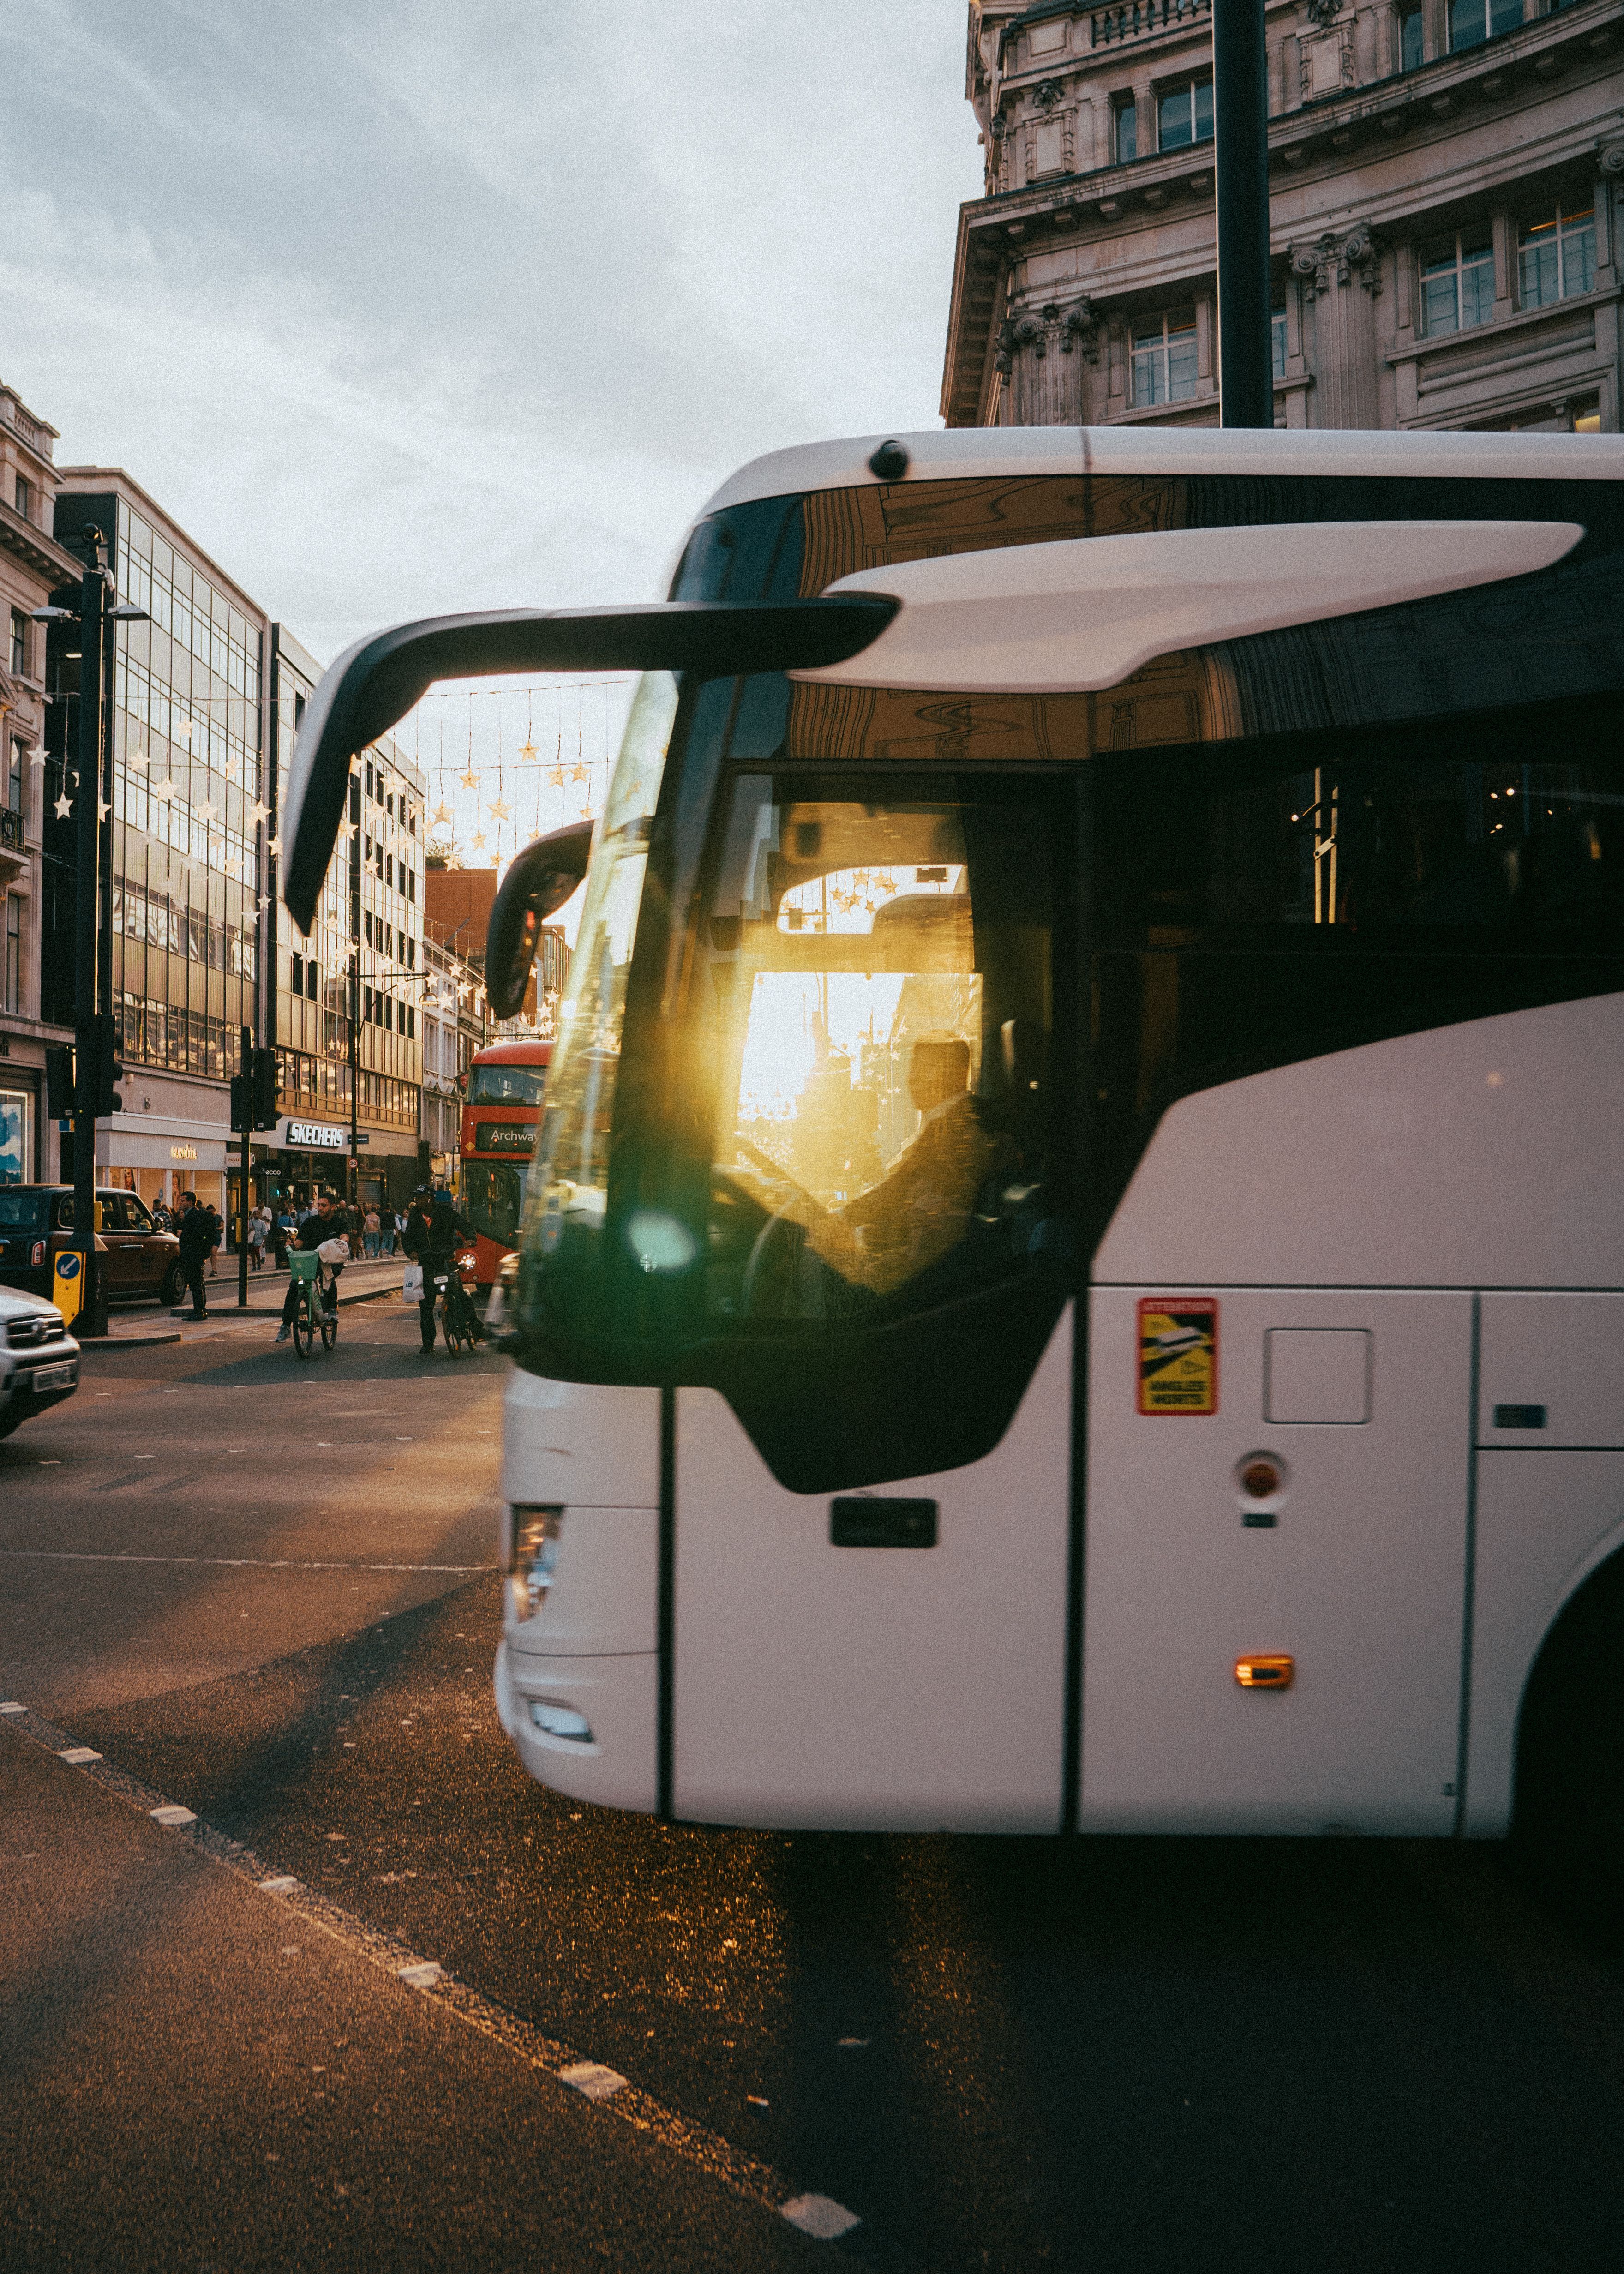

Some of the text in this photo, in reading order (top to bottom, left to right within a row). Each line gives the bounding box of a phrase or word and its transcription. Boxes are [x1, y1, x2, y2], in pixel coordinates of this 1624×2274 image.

[290, 1123, 343, 1146] SKECHERS
[491, 1130, 539, 1144] Archway
[172, 1146, 198, 1159] PANDORA
